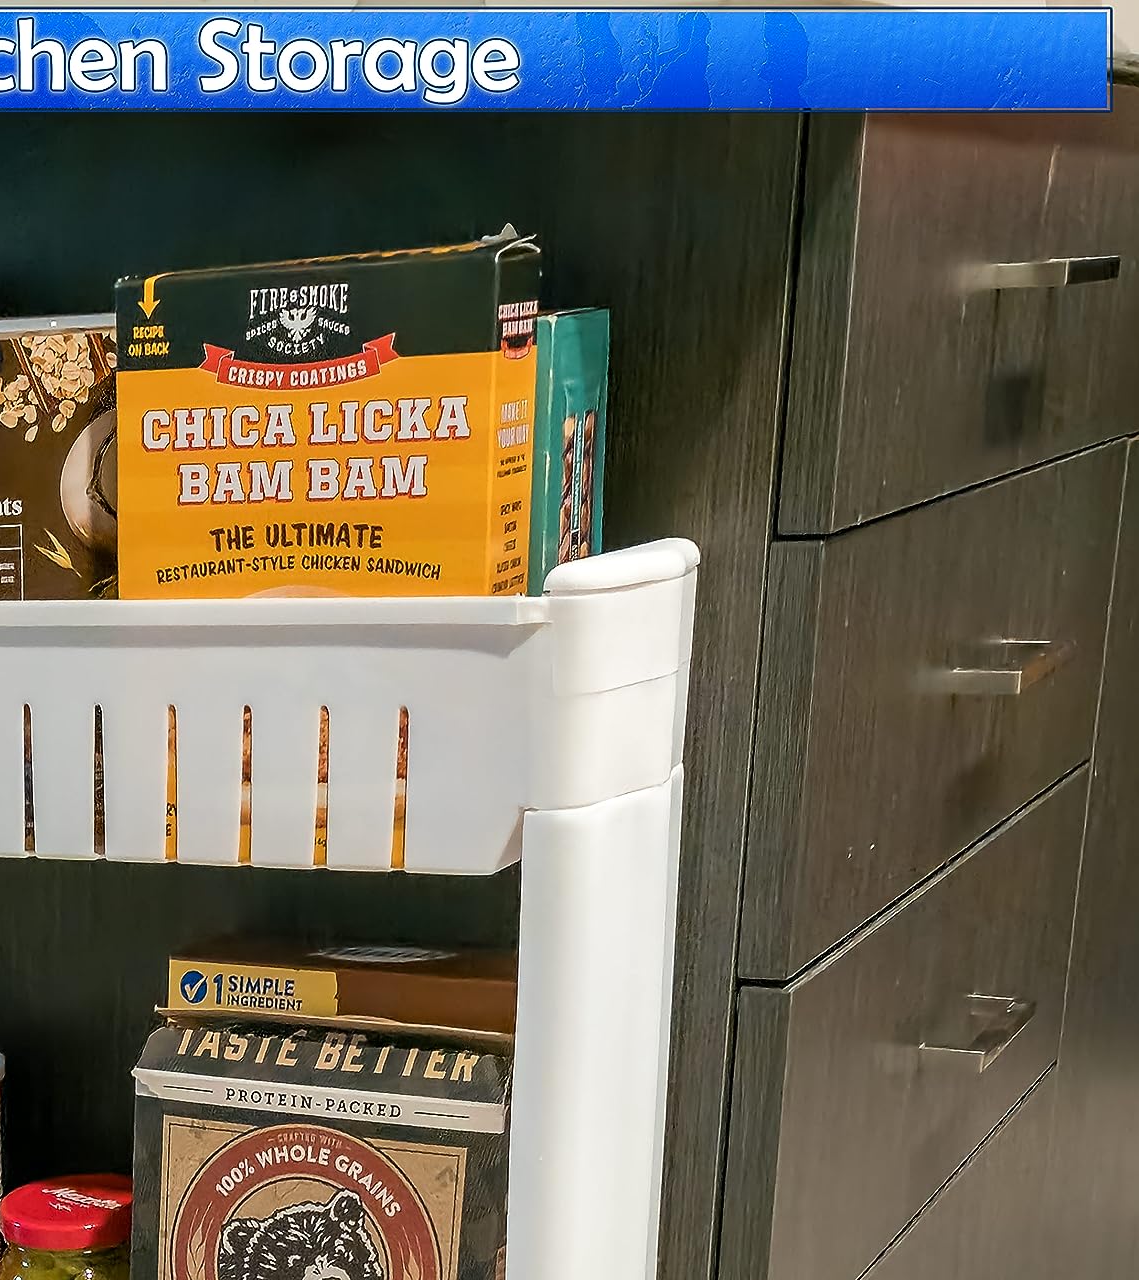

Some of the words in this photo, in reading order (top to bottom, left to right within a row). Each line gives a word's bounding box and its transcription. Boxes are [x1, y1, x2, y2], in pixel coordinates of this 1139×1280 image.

[132, 325, 165, 339] RECIPE
[267, 333, 324, 356] SOCIETY
[128, 344, 143, 356] ON
[144, 341, 170, 356] BACK
[228, 366, 284, 387] CRISPY
[290, 360, 367, 386] COATINGS
[142, 404, 297, 452] CHICA
[310, 396, 472, 445] LICKA
[178, 460, 294, 506] BAM
[307, 455, 428, 501] BAM
[209, 524, 255, 552] THE
[266, 523, 384, 549] ULTIMATE
[156, 555, 295, 584] RESTAURANT-STYLE
[301, 554, 362, 572] CHICKEN
[367, 557, 442, 580] SANDWICH
[212, 974, 223, 1005] 1
[227, 975, 295, 997] SIMPLE
[226, 994, 303, 1012] INGREDIENT
[176, 1028, 305, 1068] TASTE
[224, 1087, 403, 1119] PROTEIN-PACKED
[319, 1134, 344, 1148] WITH
[215, 1158, 255, 1198] 100%
[255, 1143, 330, 1169] WHOLE
[334, 1157, 402, 1218] GRAINS
